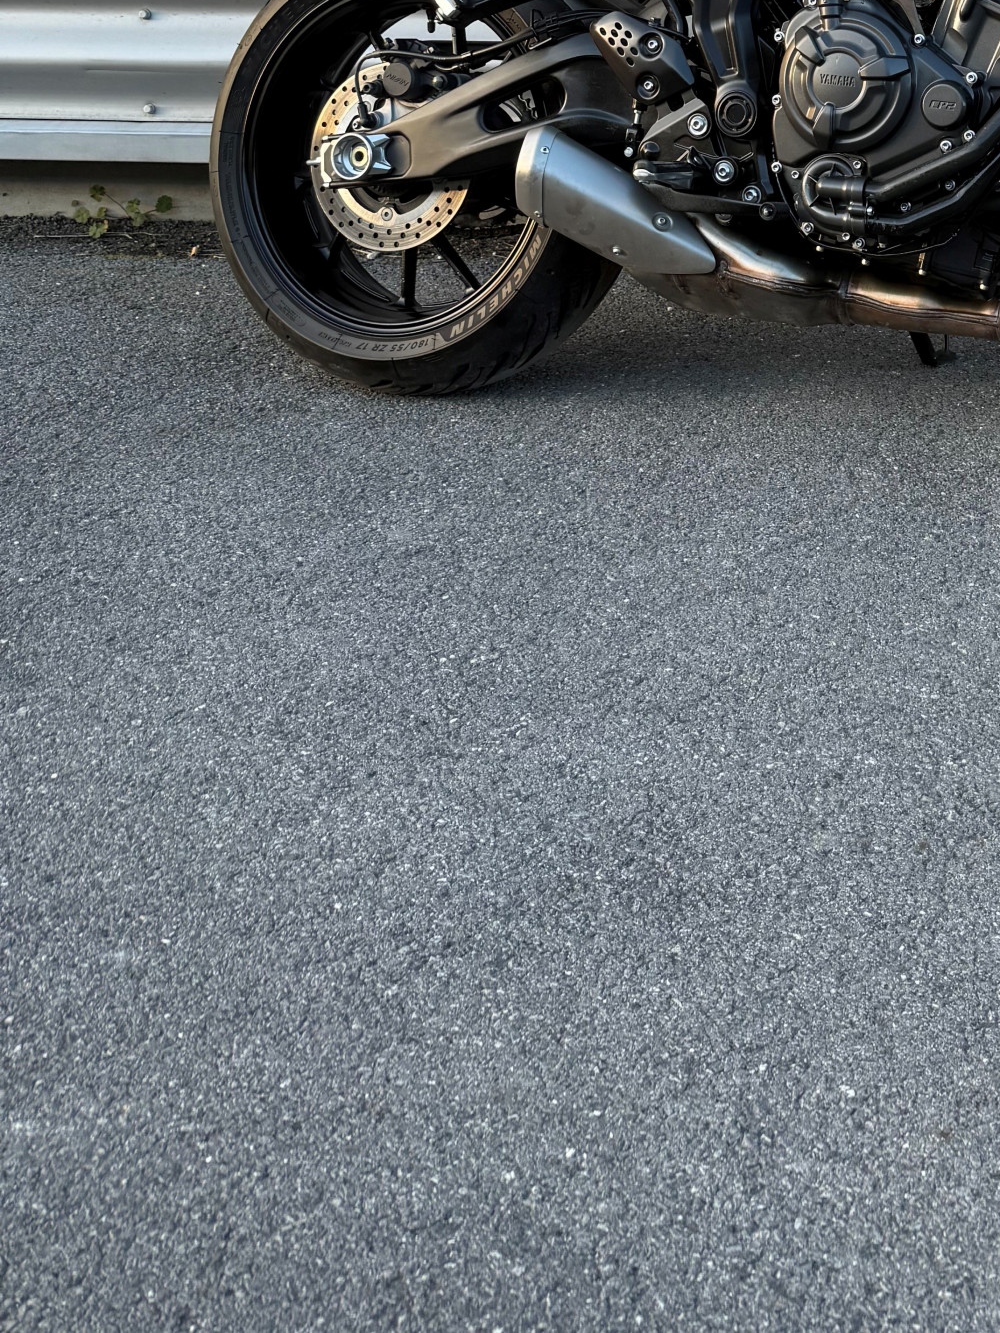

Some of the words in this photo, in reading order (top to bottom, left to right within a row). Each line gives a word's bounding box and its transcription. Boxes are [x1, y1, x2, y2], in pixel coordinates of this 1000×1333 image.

[819, 73, 856, 88] YAMAHA
[450, 234, 543, 338] MICHELIN
[355, 342, 369, 351] 17
[371, 342, 388, 352] ZR
[391, 338, 429, 352] 180/55
